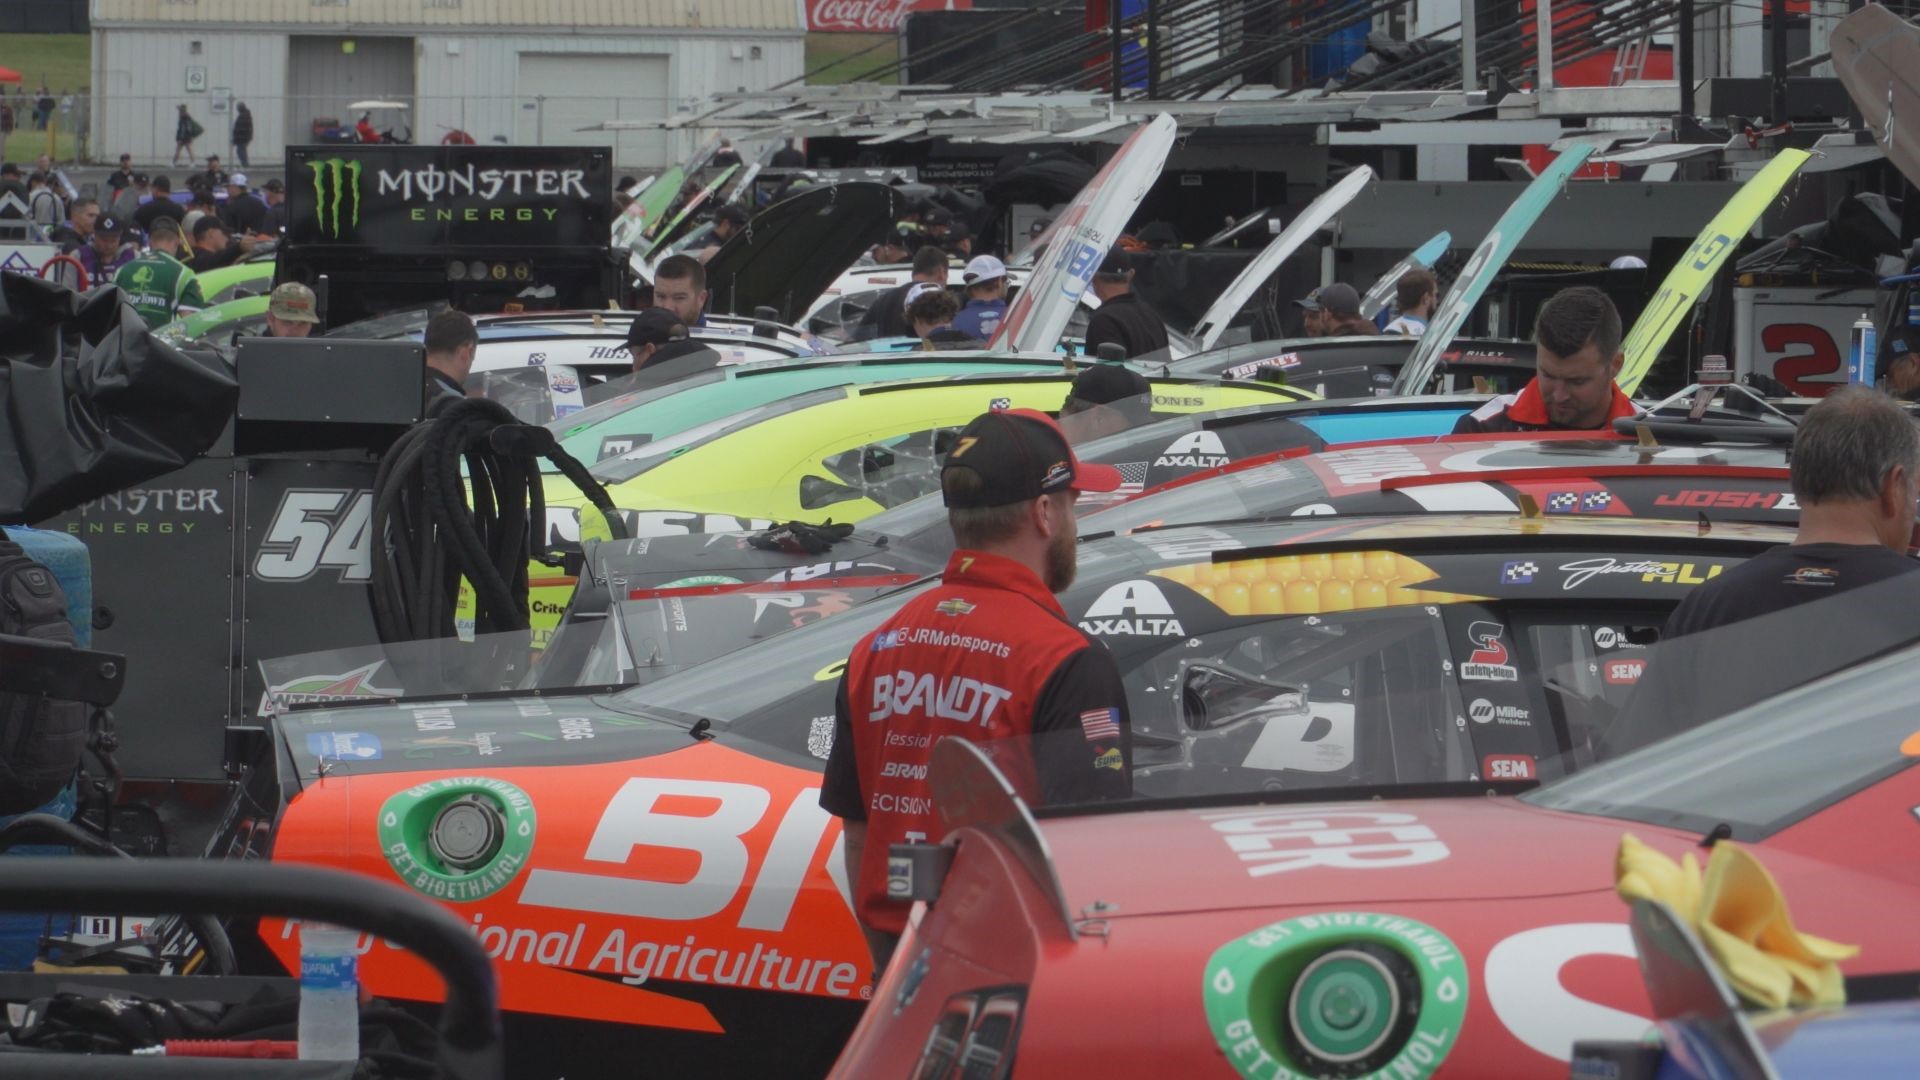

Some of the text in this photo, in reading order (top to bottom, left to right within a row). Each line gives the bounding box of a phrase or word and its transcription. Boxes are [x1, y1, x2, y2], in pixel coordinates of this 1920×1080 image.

[377, 163, 591, 201] MONSTER
[411, 208, 558, 221] ENERGY
[952, 436, 979, 457] 7
[1154, 455, 1230, 468] AXALTA
[78, 489, 223, 516] NSTER
[1654, 490, 1780, 509] JOSH
[68, 523, 194, 533] ENERGY
[252, 488, 374, 584] 54
[959, 557, 976, 574] 7
[1079, 618, 1185, 636] AXALTA
[1612, 664, 1642, 679] SEM
[1496, 706, 1529, 719] Miller
[1498, 718, 1531, 727] Welders
[1491, 760, 1529, 778] SEM
[407, 783, 436, 798] GET
[390, 842, 524, 899] GET BIOETHANOL
[1248, 923, 1294, 949] GET
[588, 928, 858, 997] Agriculture
[1225, 1018, 1272, 1076] GET
